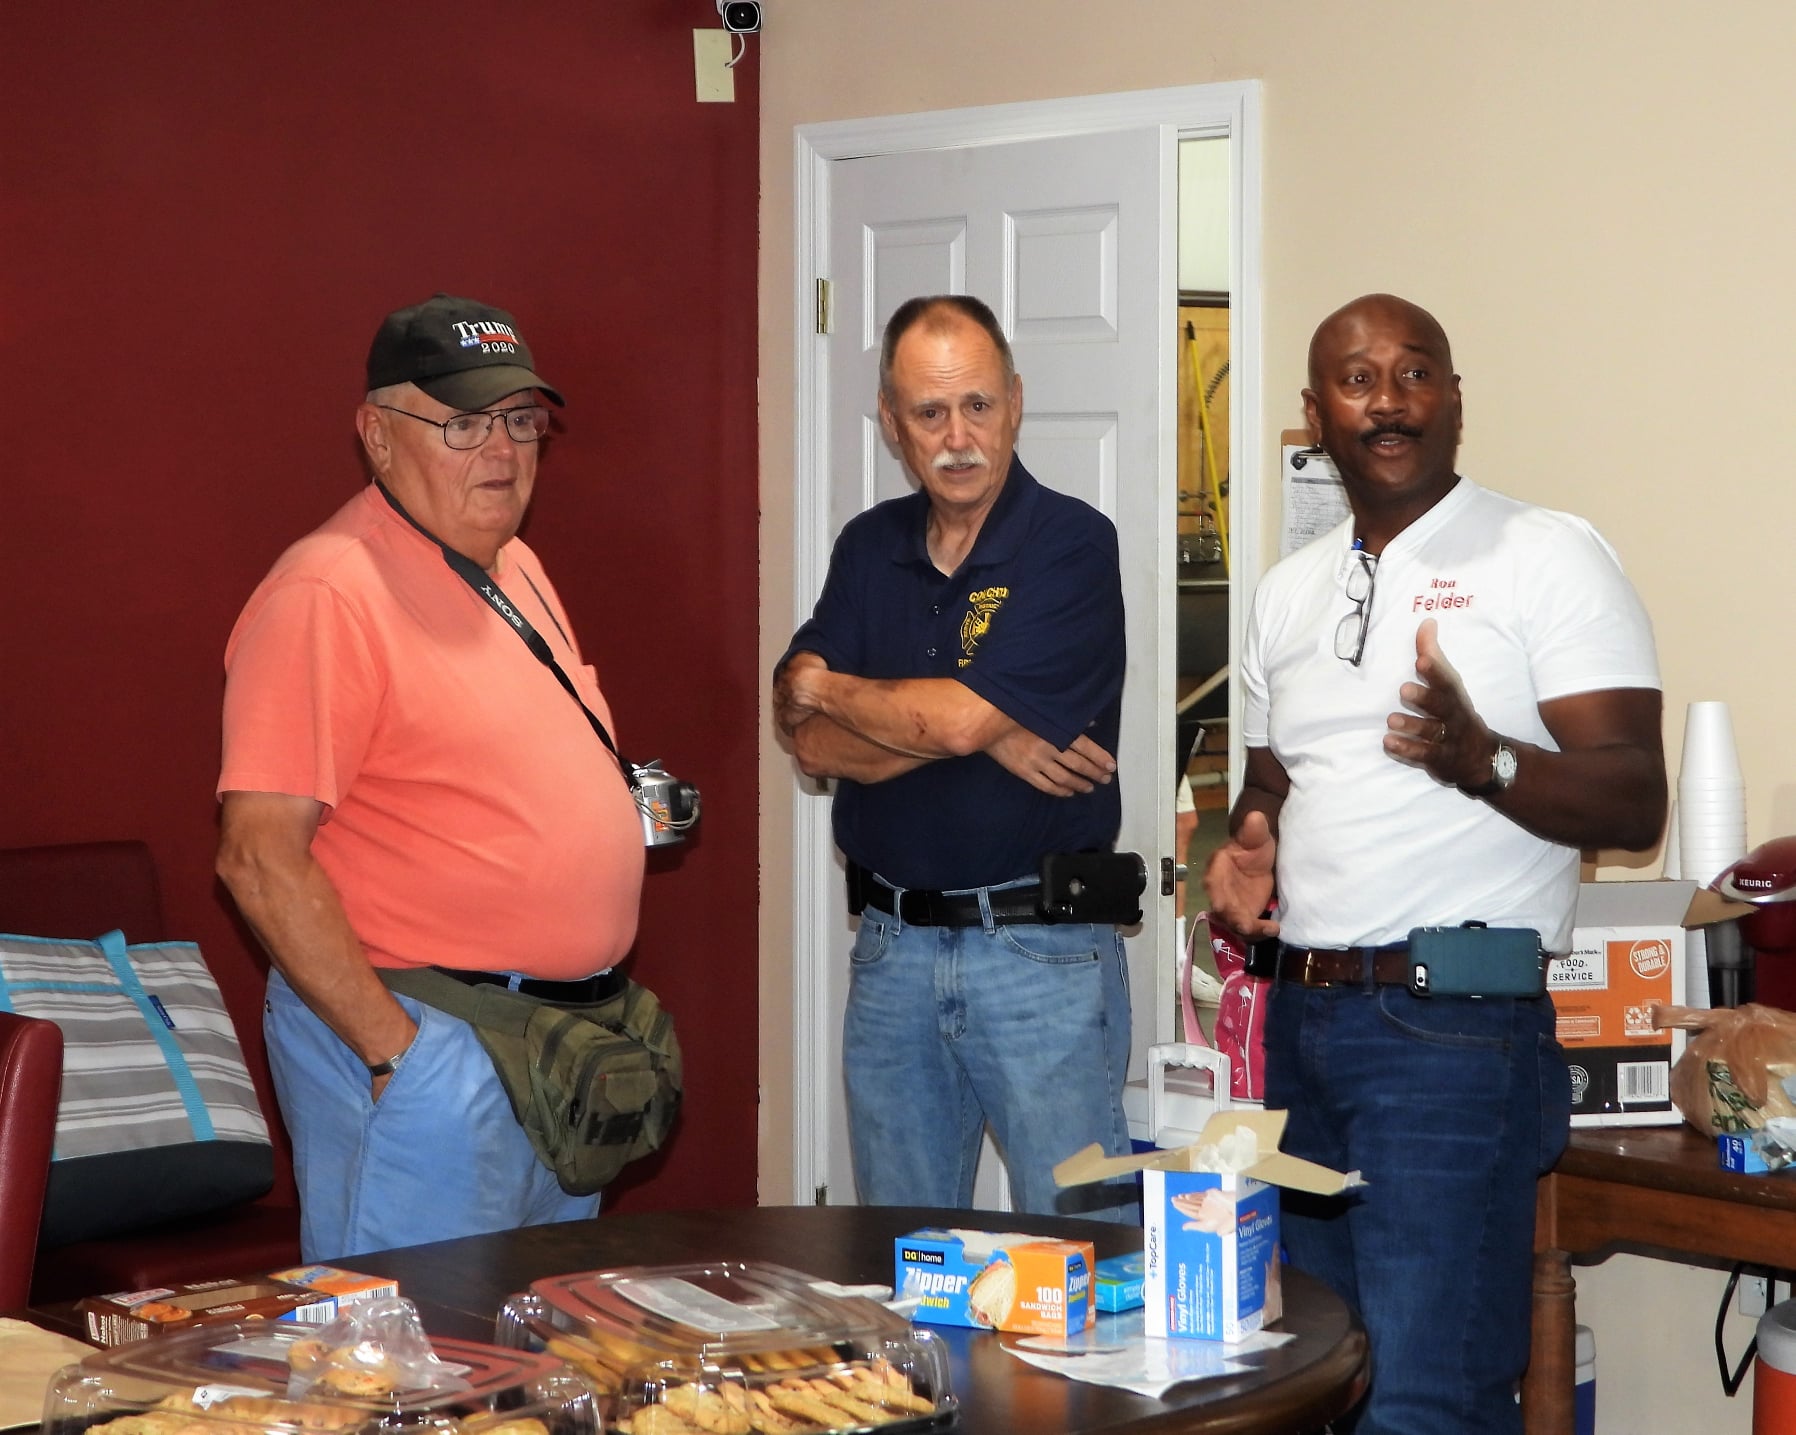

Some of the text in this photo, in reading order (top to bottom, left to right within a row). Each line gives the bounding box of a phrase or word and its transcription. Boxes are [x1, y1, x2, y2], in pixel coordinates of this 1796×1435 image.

[452, 320, 519, 345] Trump
[481, 341, 515, 353] 2020
[1430, 578, 1457, 589] Ron
[480, 584, 523, 628] SONY
[1412, 592, 1474, 613] Felder
[1739, 878, 1772, 888] KEURIG
[1633, 945, 1658, 962] STRONG
[1560, 959, 1584, 969] FOOD
[1552, 971, 1593, 981] SERVICE
[1149, 1226, 1159, 1270] TopCare
[1036, 1286, 1063, 1303] 100
[1177, 1262, 1189, 1333] Vinyl Gloves
[1020, 1301, 1063, 1312] SANDWICH
